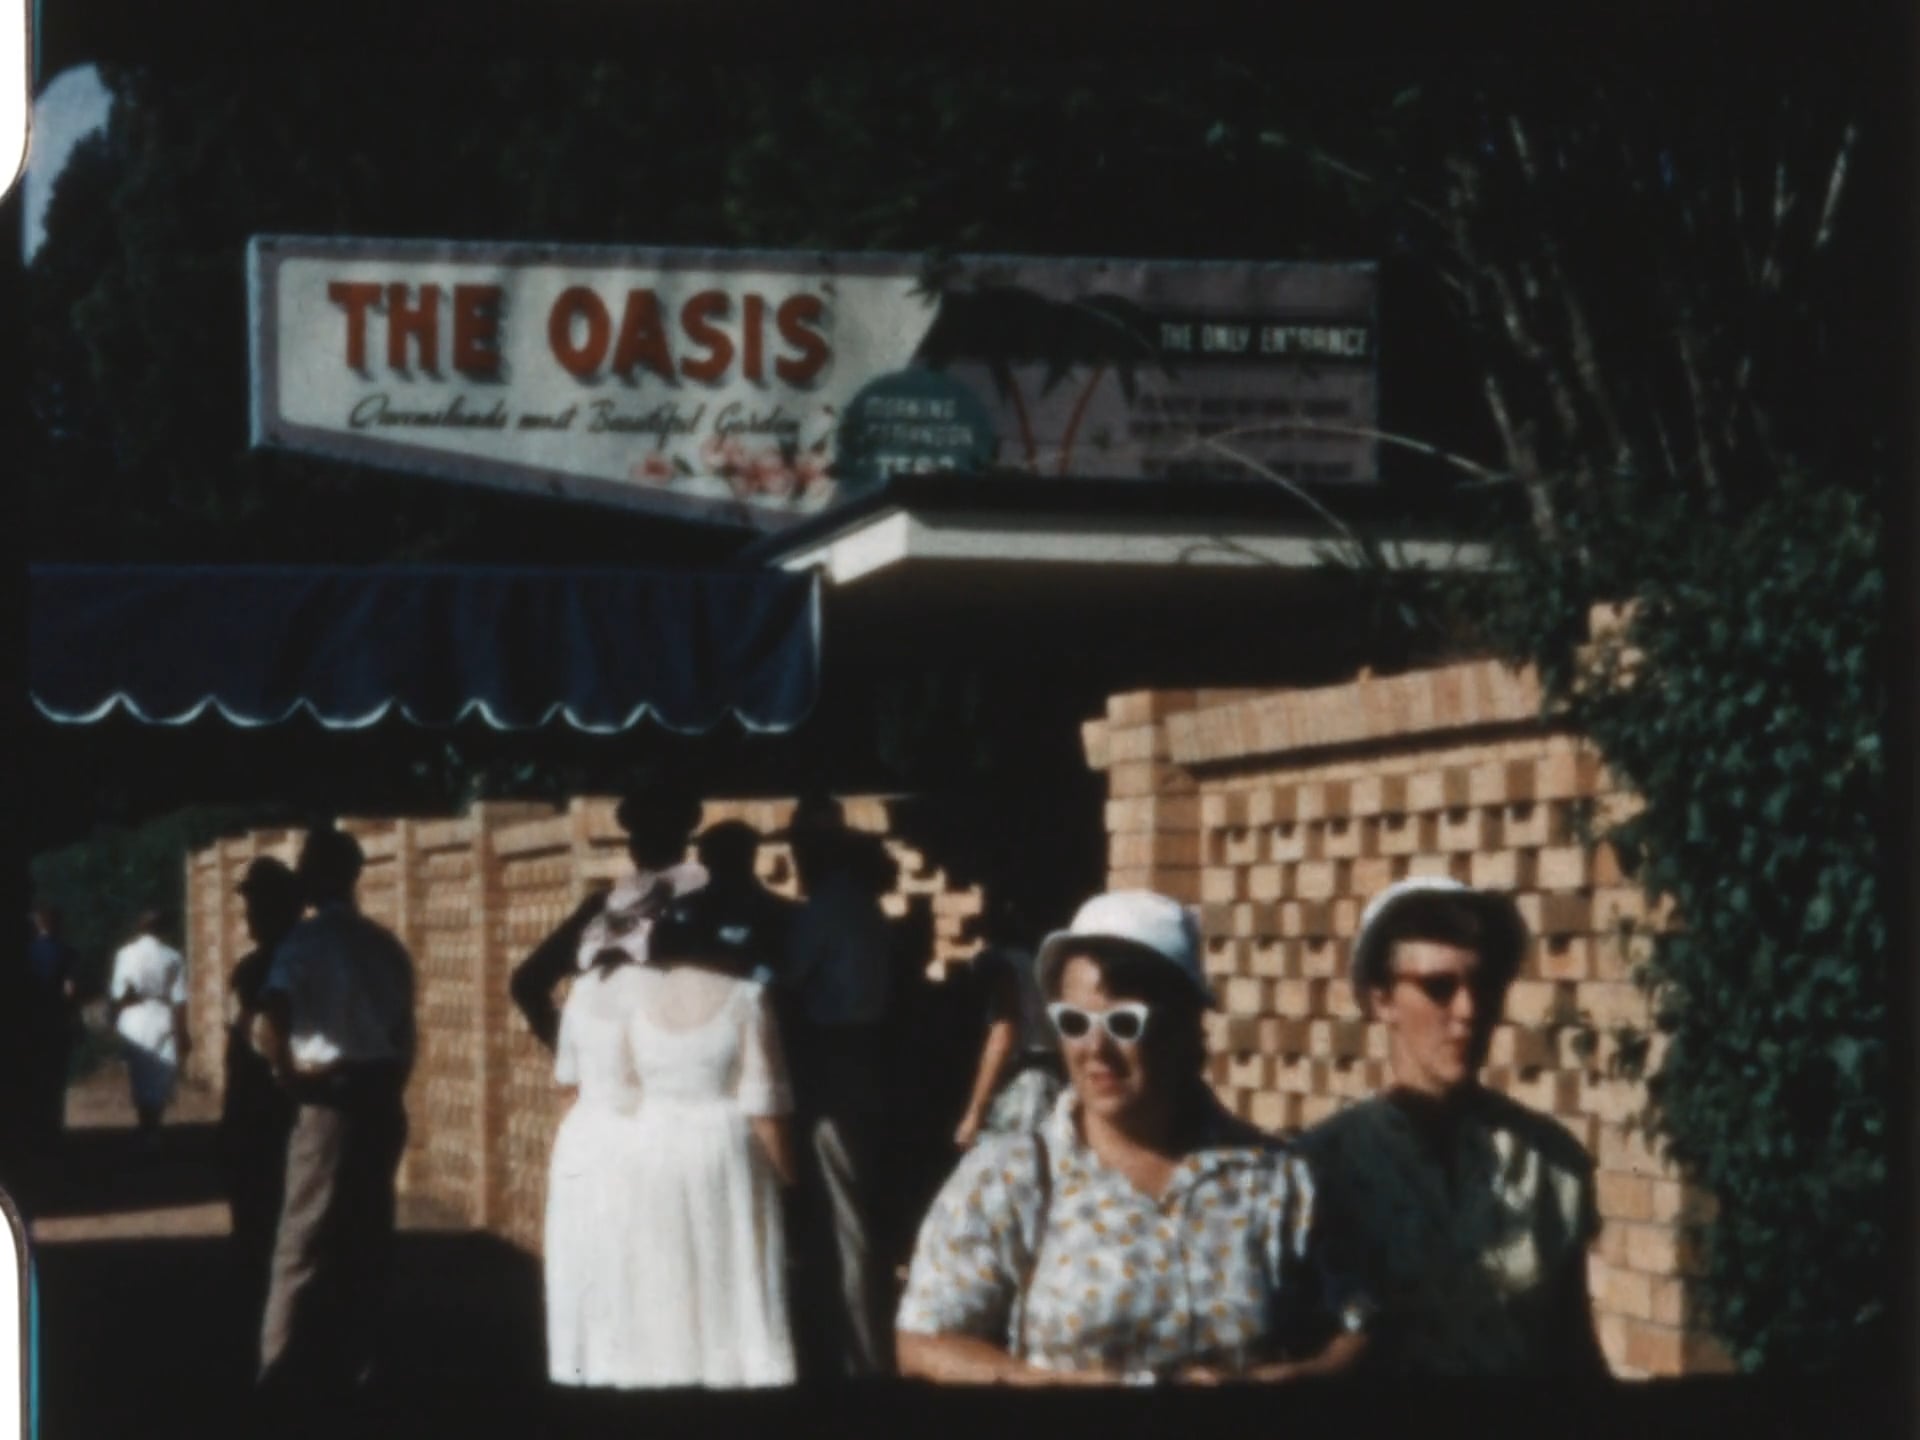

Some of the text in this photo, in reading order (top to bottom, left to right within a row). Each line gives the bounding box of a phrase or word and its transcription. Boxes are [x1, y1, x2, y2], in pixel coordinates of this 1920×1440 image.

[328, 281, 832, 386] THE OASIS
[1160, 322, 1193, 353] THE
[1201, 324, 1251, 354] ONLY
[587, 397, 707, 450] Beautiful
